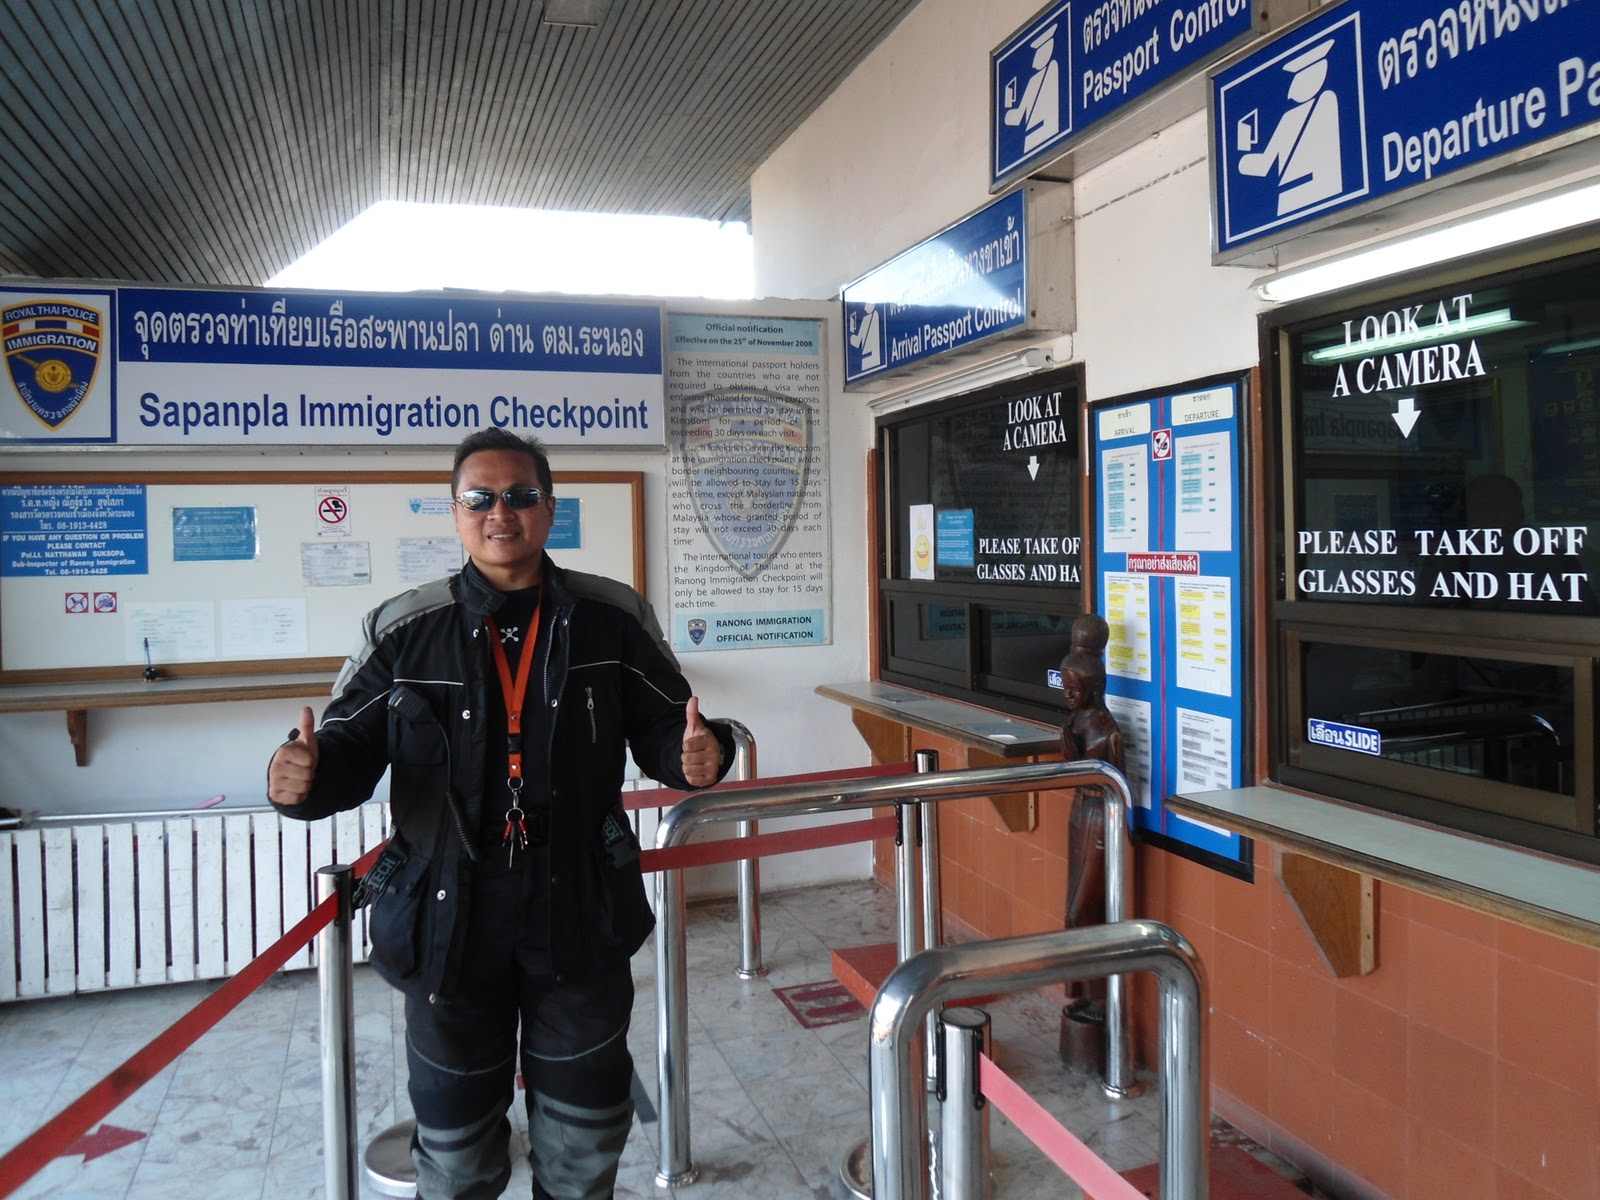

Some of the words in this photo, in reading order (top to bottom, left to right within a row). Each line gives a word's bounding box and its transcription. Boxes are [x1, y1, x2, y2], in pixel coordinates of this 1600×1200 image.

[1083, 26, 1159, 109] Passport
[1169, 0, 1249, 53] Contro
[1383, 87, 1546, 181] Departure
[5, 307, 37, 321] ROYAL
[38, 306, 60, 315] THAI
[62, 307, 97, 322] POLICE
[1342, 305, 1423, 348] LOOK
[1434, 294, 1473, 332] AT
[134, 297, 479, 360] จุดตรวจท่าเทียบเรือสะพานปลา
[490, 308, 534, 353] ด่าน
[543, 323, 644, 357] ตม.ระนอง
[706, 324, 736, 333] Official
[737, 324, 783, 333] notification
[891, 328, 921, 362] Arrival
[924, 311, 972, 348] Passport
[975, 288, 1021, 331] Control
[7, 335, 97, 351] IMMIGRATION
[677, 358, 692, 366] The
[697, 359, 748, 367] international
[752, 361, 786, 370] passport
[790, 361, 819, 369] holders
[1332, 364, 1350, 398] A
[1356, 340, 1486, 394] CAMERA
[139, 392, 288, 435] Sapanpla
[300, 394, 479, 436] Immigration
[490, 395, 648, 436] Checkpoint
[1008, 395, 1043, 424] LOOK
[1045, 392, 1062, 417] AT
[1184, 410, 1219, 422] DEPARTURE
[1003, 429, 1011, 451] A
[1014, 419, 1067, 449] CAMERA
[1114, 427, 1135, 436] ARRIVAL
[672, 478, 687, 486] will
[706, 478, 738, 486] allowed
[755, 480, 770, 488] stay
[775, 478, 786, 486] for
[803, 478, 821, 487] days
[694, 491, 715, 499] time,
[717, 492, 743, 500] except
[746, 490, 784, 500] Malaysian
[787, 490, 821, 498] nationals
[673, 502, 691, 510] who
[730, 502, 744, 510] the
[753, 501, 794, 509] borderline
[803, 501, 821, 509] from
[57, 521, 107, 529] 08-1913-4428
[673, 514, 709, 524] Malaysia
[746, 513, 777, 523] granted
[783, 512, 809, 523] period
[673, 527, 690, 535] stay
[695, 525, 710, 533] will
[781, 524, 799, 533] days
[979, 538, 1020, 554] PLEASE
[1024, 538, 1058, 554] TAKE
[1062, 537, 1080, 554] OF
[1298, 530, 1398, 555] PLEASE
[1415, 528, 1504, 556] TAKE
[1513, 526, 1588, 556] OFF
[97, 559, 135, 567] Immigration
[683, 553, 698, 561] The
[700, 552, 750, 561] international
[780, 551, 797, 559] who
[1128, 554, 1197, 573] กรุณาอย่าส่งเสียงดัง
[675, 565, 688, 573] the
[695, 564, 733, 575] Kingdom
[977, 564, 1025, 581] GLASSES
[1030, 564, 1057, 581] AND
[1060, 564, 1081, 582] HA
[675, 577, 706, 585] Ranong
[710, 575, 758, 585] Immigration
[762, 574, 806, 584] Checkpoint
[1298, 569, 1416, 596] GLASSES
[1430, 571, 1498, 599] AND
[1507, 572, 1588, 602] HAT
[675, 589, 692, 598] only
[697, 588, 707, 596] be
[711, 587, 742, 595] allowed
[758, 587, 774, 595] stay
[778, 585, 788, 593] for
[806, 585, 823, 594] days
[716, 619, 752, 627] RANONG
[756, 617, 812, 626] IMMIGRATION
[717, 634, 753, 642] OFFICIAL
[757, 632, 813, 640] NOTIFICATION
[1344, 730, 1378, 752] SLIDE
[367, 856, 396, 889] TECH
